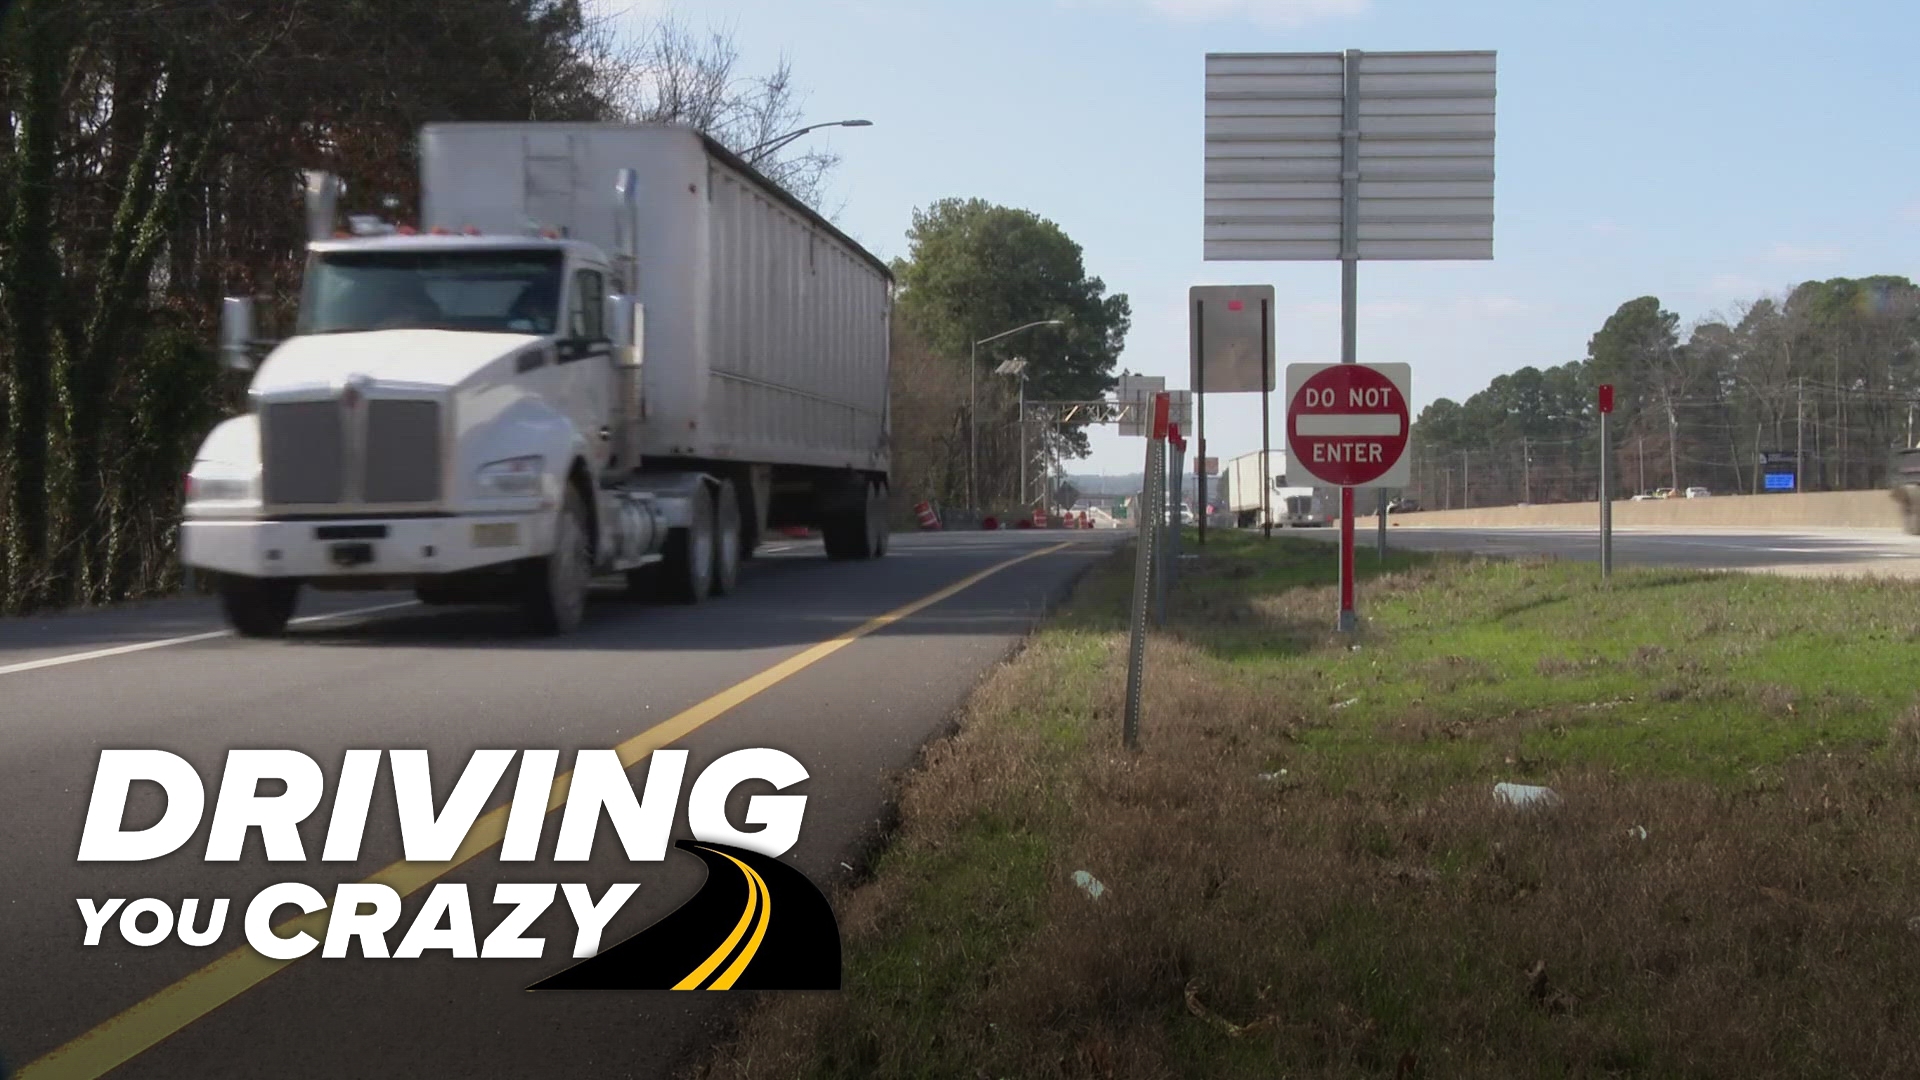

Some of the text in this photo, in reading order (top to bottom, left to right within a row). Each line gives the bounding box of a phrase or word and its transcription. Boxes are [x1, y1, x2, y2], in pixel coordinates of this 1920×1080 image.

[1306, 387, 1392, 407] DO NOT
[1313, 443, 1382, 462] ENTER
